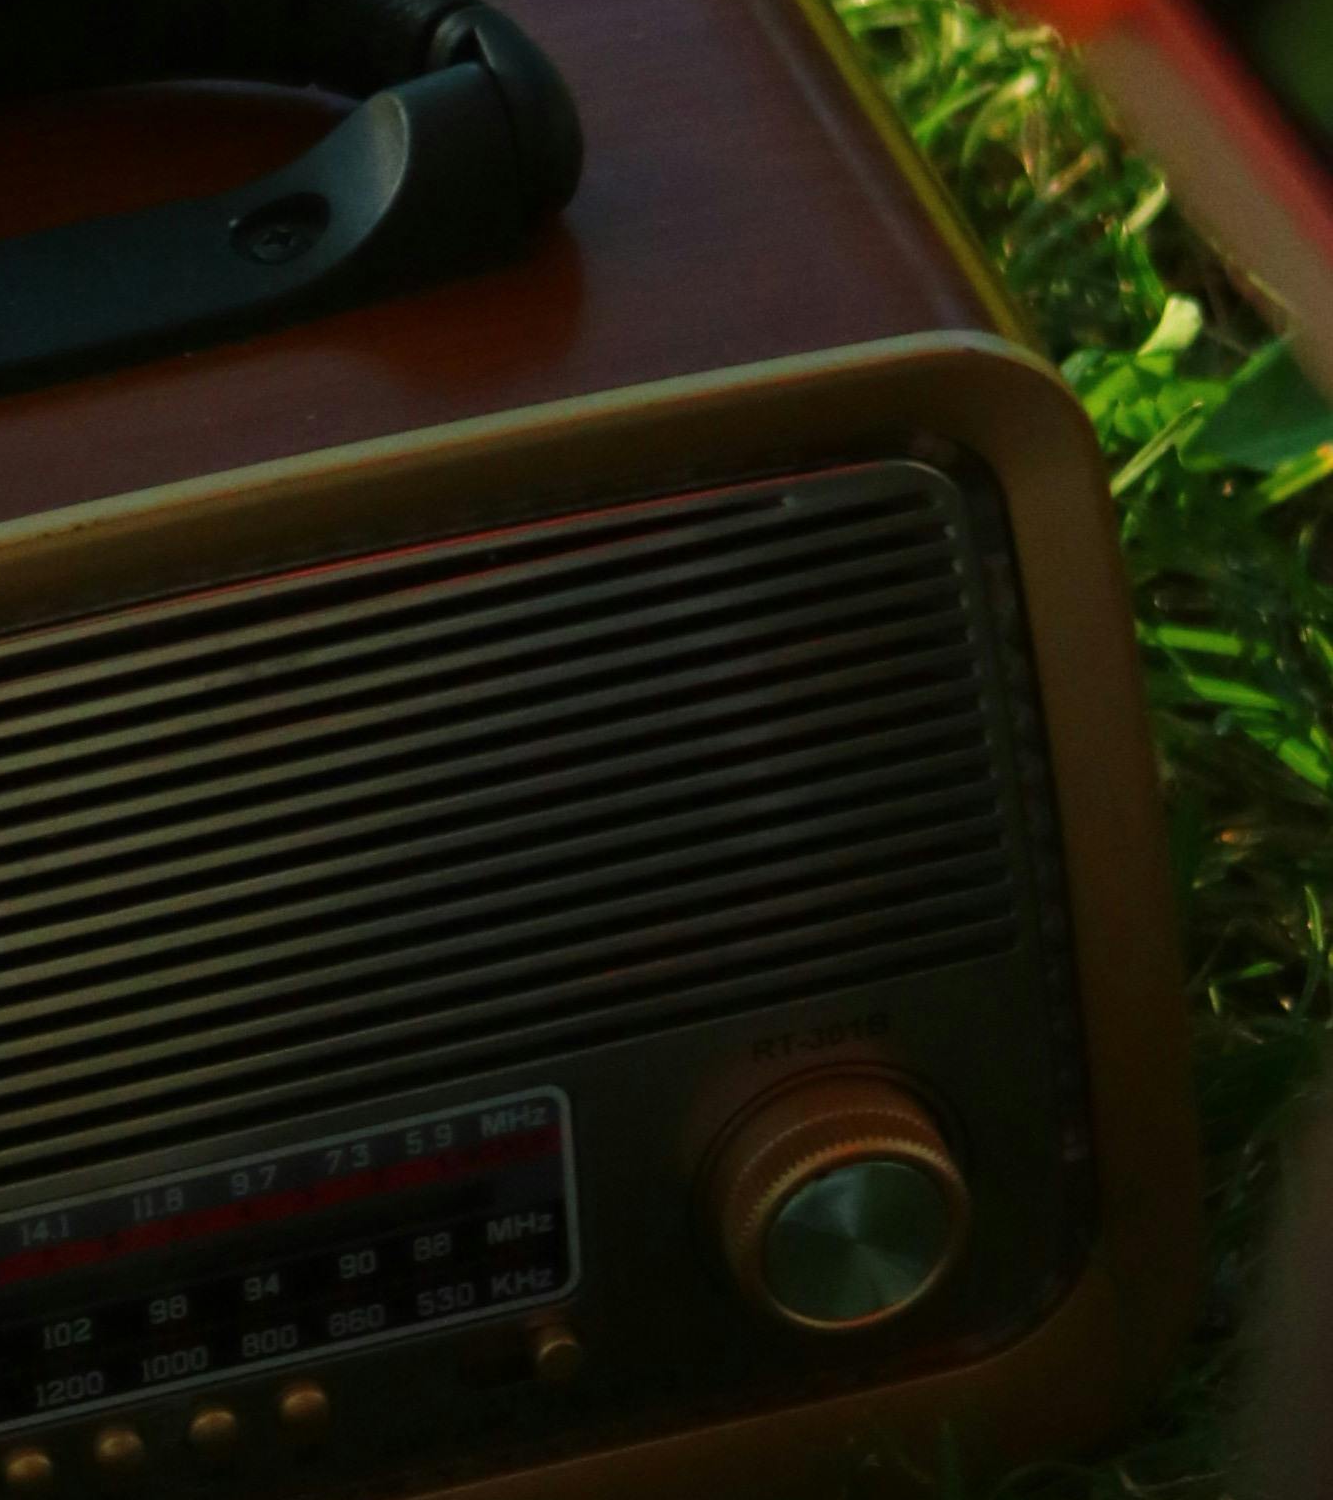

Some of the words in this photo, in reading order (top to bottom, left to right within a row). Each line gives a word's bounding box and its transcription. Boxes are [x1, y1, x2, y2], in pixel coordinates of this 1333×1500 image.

[20, 1213, 71, 1247] 14.1
[131, 1186, 185, 1221] 11.8
[480, 1103, 549, 1137] MHz
[35, 1369, 105, 1409] 1200
[140, 1344, 210, 1383] 1000
[240, 1324, 299, 1358] 800
[416, 1282, 475, 1316] 530
[489, 1265, 555, 1300] KHz
[41, 1316, 94, 1350] 102
[148, 1294, 189, 1325] 98
[243, 1270, 281, 1303] 94
[337, 1250, 378, 1280] 90
[412, 1232, 453, 1262] 88
[486, 1210, 554, 1243] MHz
